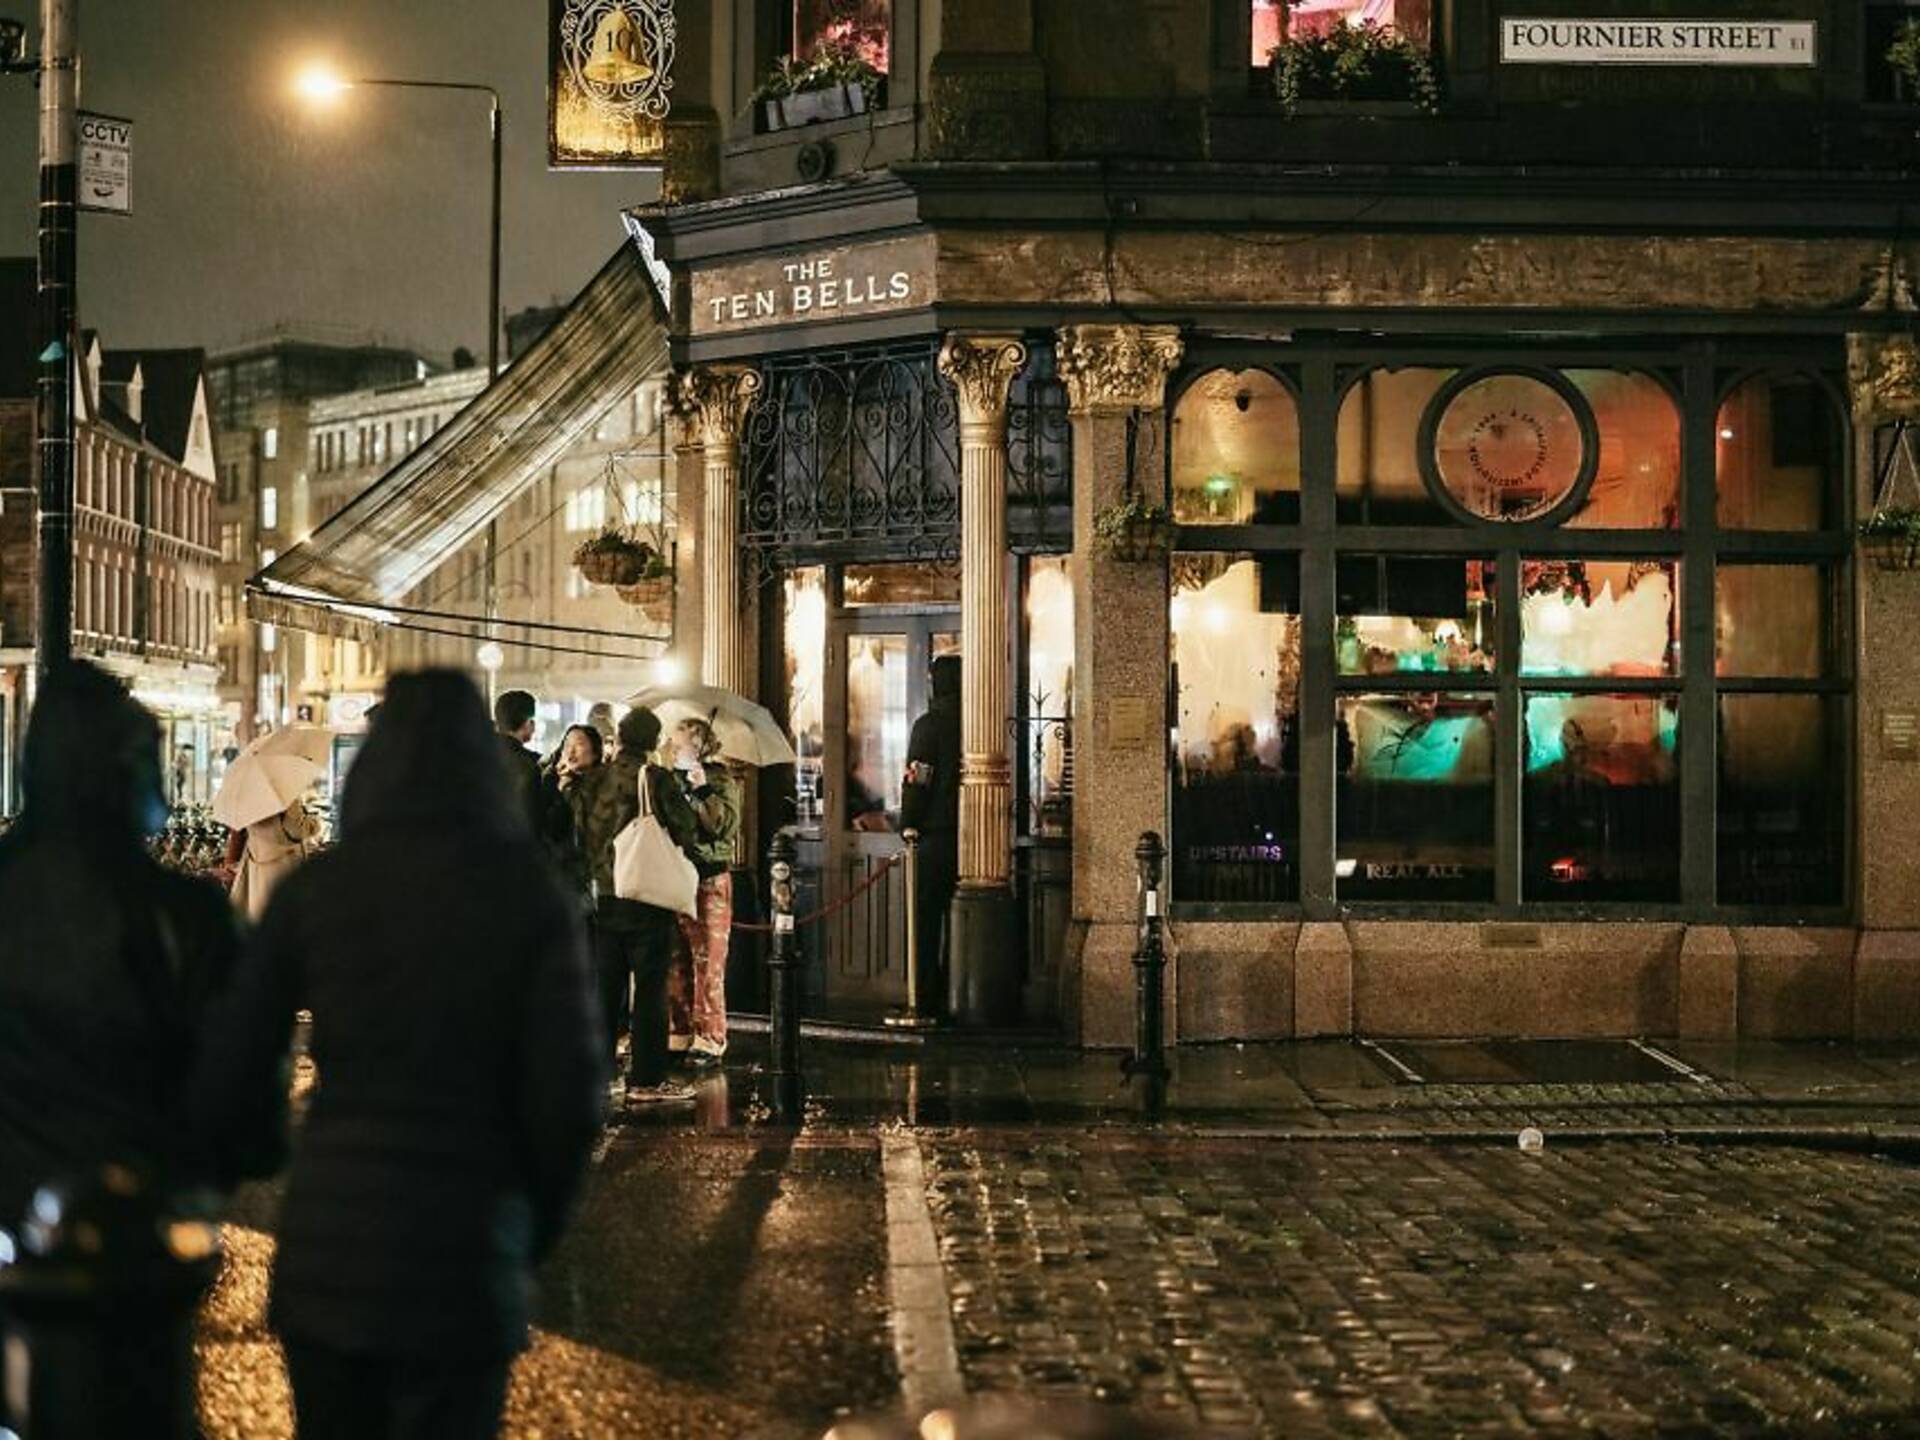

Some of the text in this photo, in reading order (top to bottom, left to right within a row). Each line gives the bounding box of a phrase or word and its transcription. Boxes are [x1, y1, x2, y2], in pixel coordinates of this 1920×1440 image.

[605, 27, 632, 52] 10
[1511, 23, 1664, 48] FOURNIER
[1672, 26, 1782, 49] STREET
[82, 122, 129, 144] CCTV
[783, 259, 833, 282] THE
[710, 271, 910, 322] TEN BELLS
[1366, 862, 1421, 880] REAL
